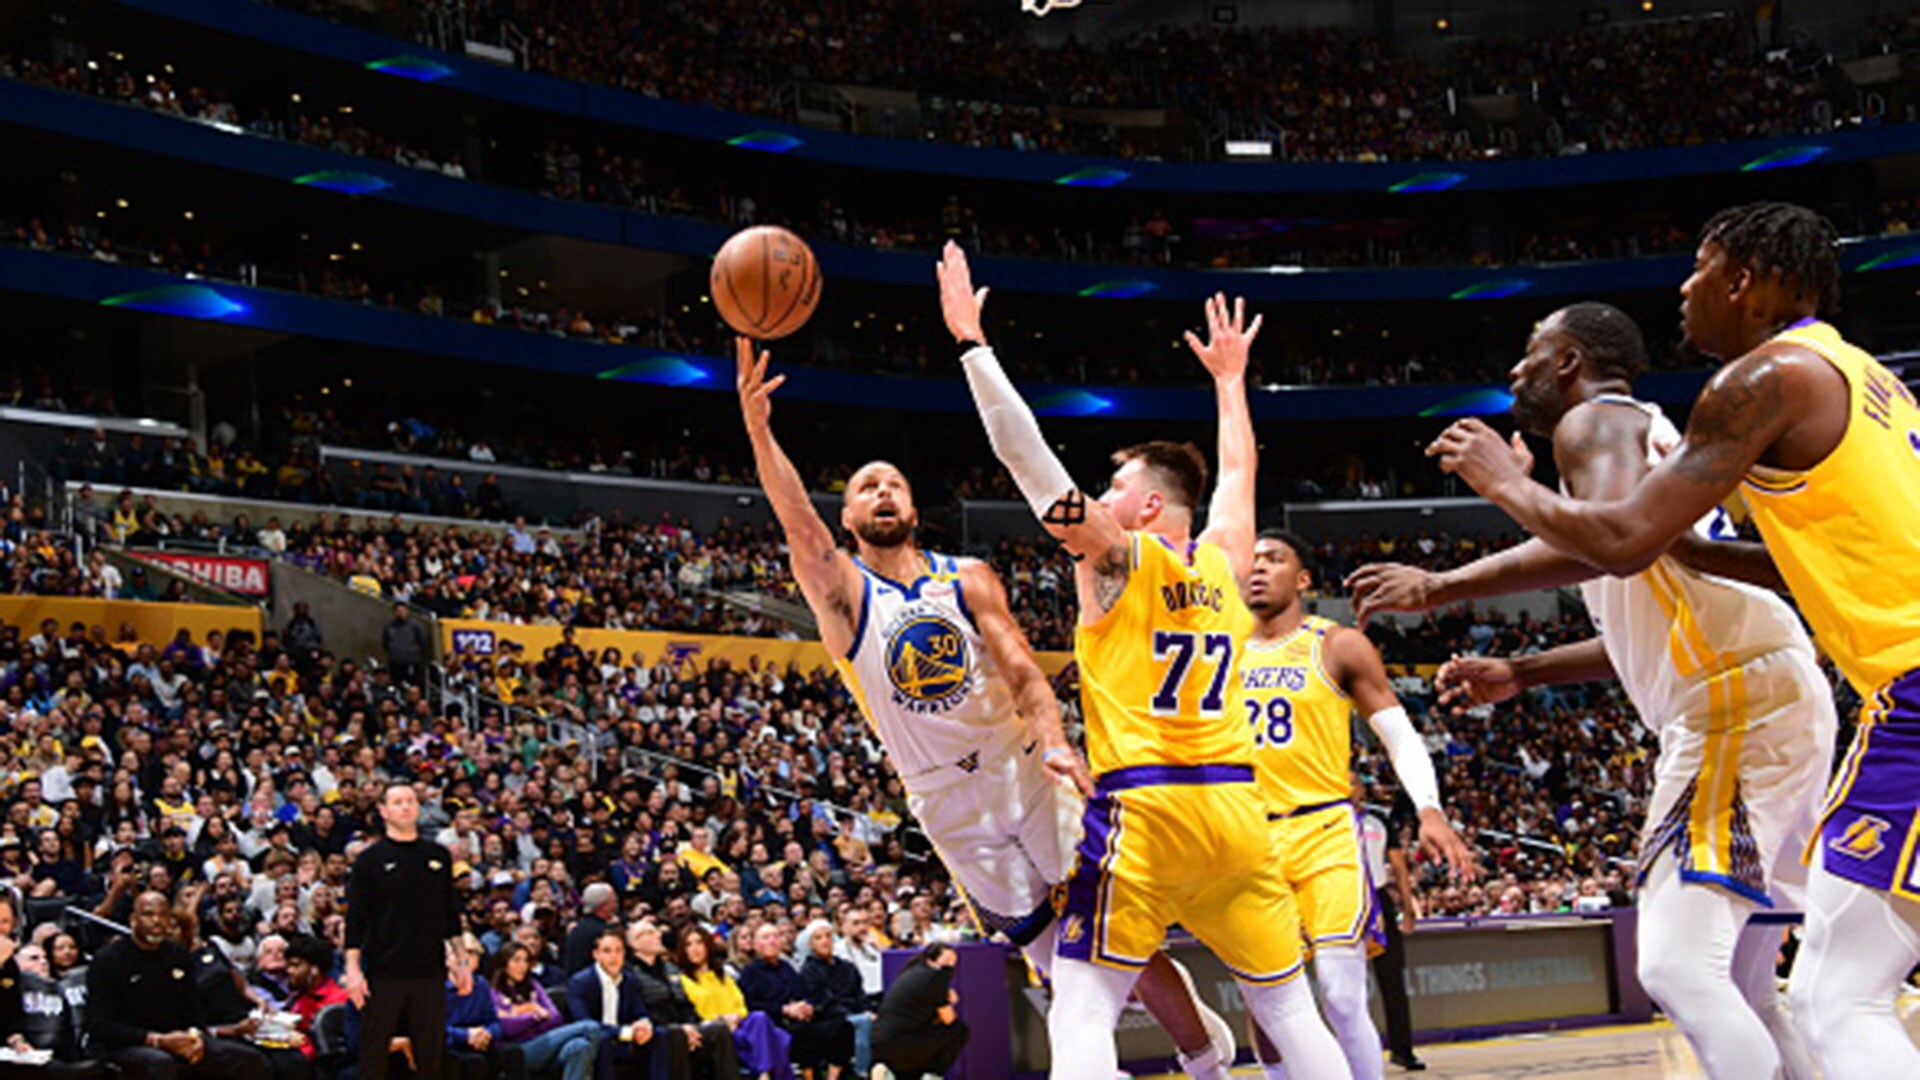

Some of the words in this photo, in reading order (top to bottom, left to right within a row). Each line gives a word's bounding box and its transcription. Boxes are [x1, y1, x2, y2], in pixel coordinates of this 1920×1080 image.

[928, 634, 959, 659] 30
[1152, 630, 1233, 717] 77
[1415, 962, 1486, 996] THINGS
